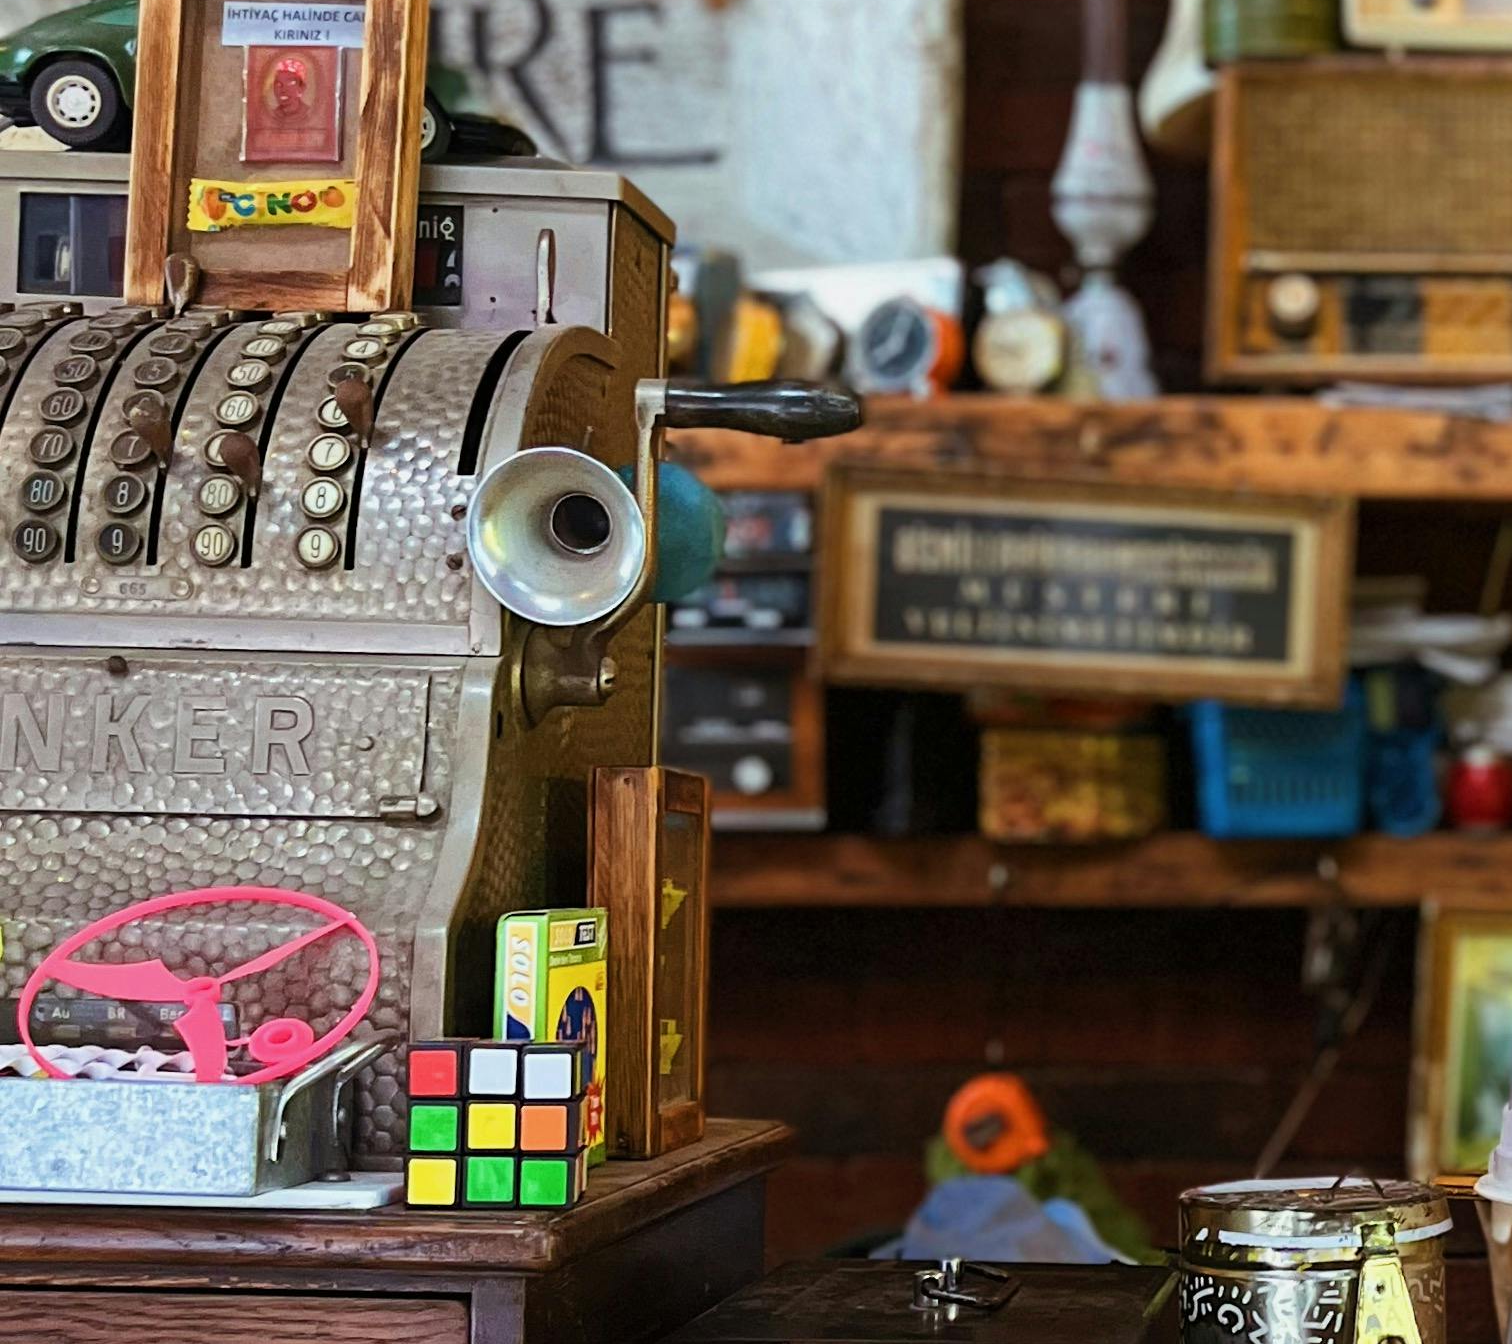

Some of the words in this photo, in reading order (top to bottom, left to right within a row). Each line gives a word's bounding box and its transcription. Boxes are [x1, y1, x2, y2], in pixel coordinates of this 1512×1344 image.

[227, 8, 278, 22] İHTİYAÇ
[283, 9, 340, 23] HALİNDE
[274, 29, 321, 41] KIRINIZ
[236, 364, 259, 381] 50
[51, 394, 75, 417] 60
[225, 396, 248, 419] 60
[39, 432, 63, 457] 70
[325, 442, 336, 462] 7
[29, 479, 54, 505] 80
[117, 481, 128, 506] 8
[203, 483, 228, 509] 80
[315, 485, 327, 509] 8
[23, 528, 46, 553] 90
[112, 529, 123, 555] 9
[199, 532, 224, 558] 90
[310, 533, 322, 559] 9
